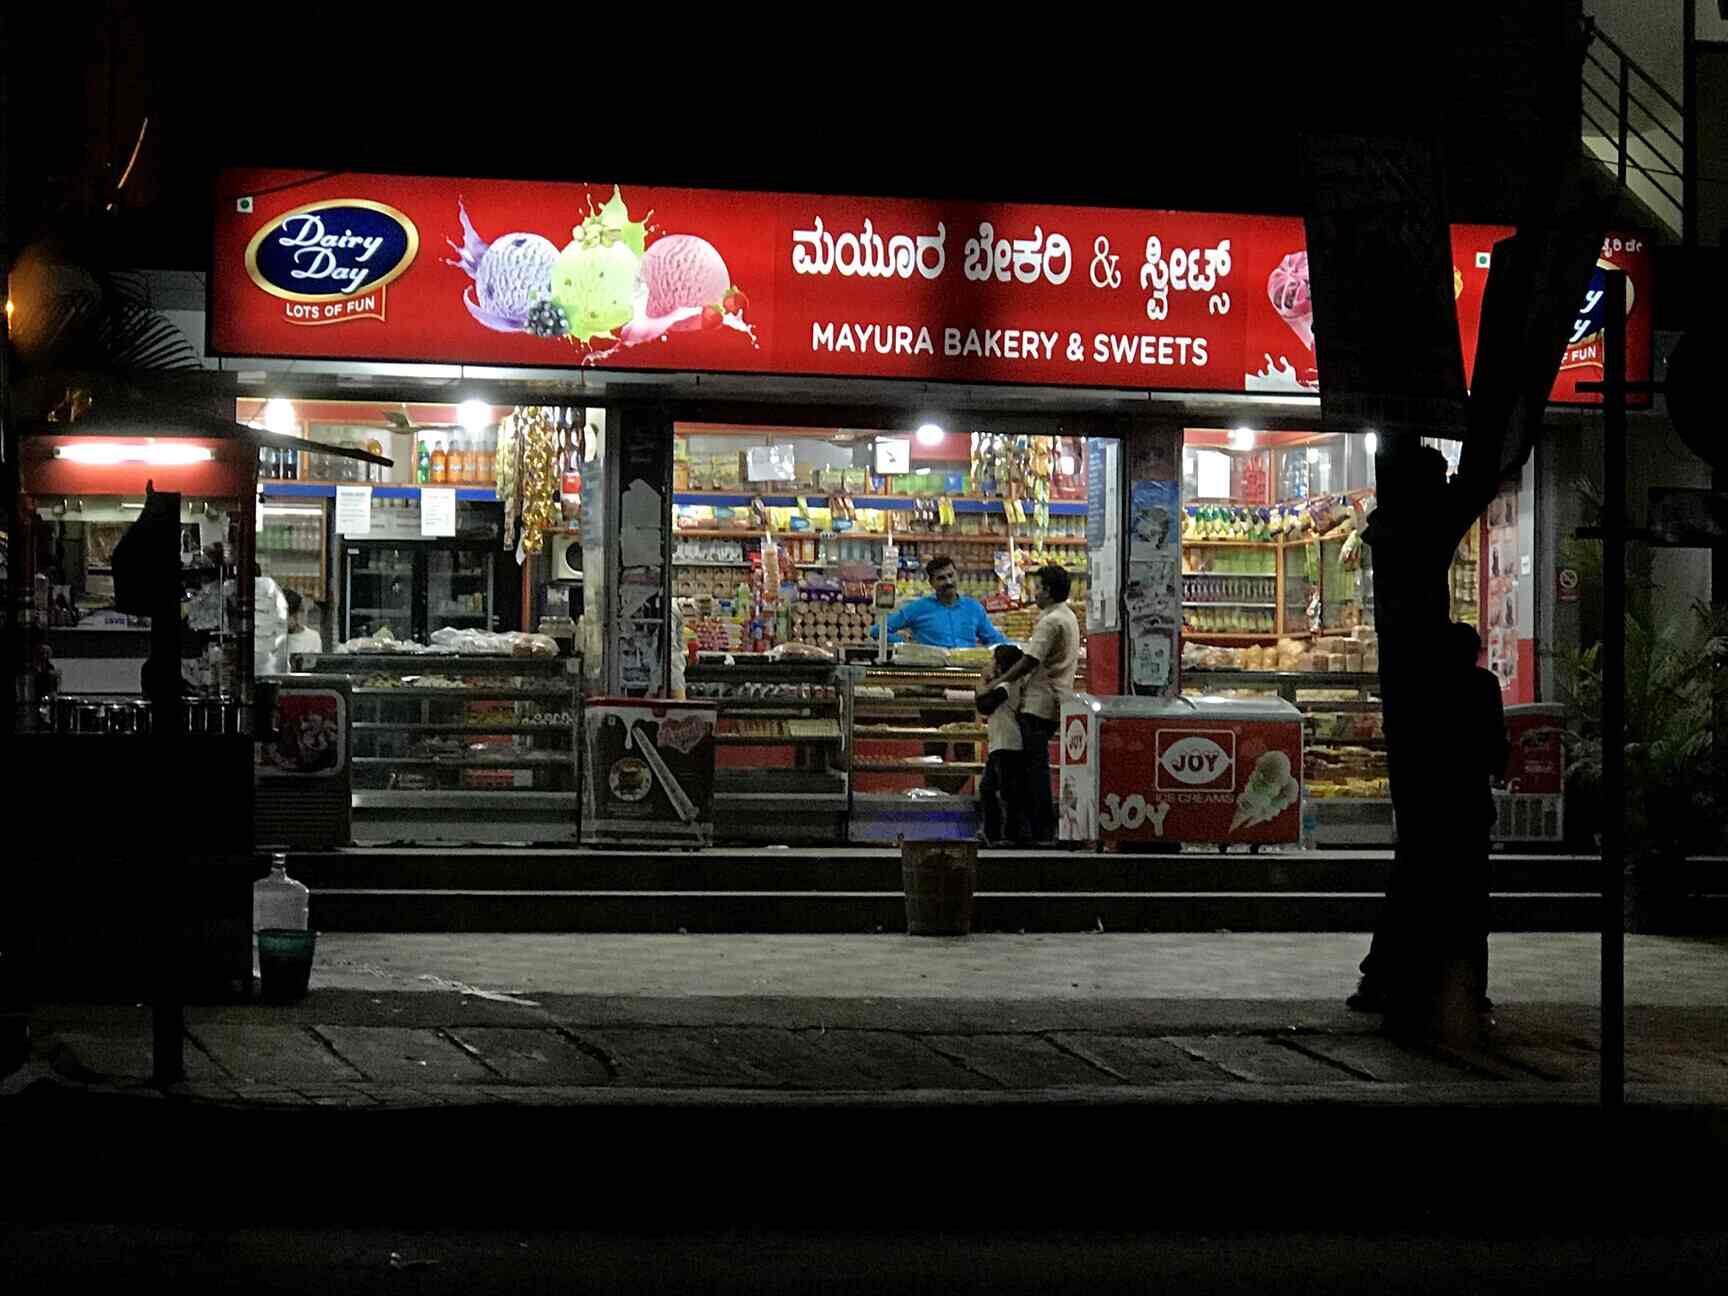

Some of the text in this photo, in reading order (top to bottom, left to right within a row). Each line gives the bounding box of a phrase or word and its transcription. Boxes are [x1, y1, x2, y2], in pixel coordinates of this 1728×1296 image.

[279, 214, 384, 262] Dairy
[792, 215, 946, 280] ಮಯೂರ
[964, 222, 1072, 286] ಬೇಕರಿ
[1090, 235, 1122, 289] &
[290, 246, 369, 293] Day
[286, 295, 375, 319] LOTS OF FUN
[812, 321, 1209, 367] MAYURA BAKERY & SWEETS
[1572, 346, 1597, 361] FUN
[1172, 753, 1219, 772] JOY
[1100, 793, 1170, 836] JOY
